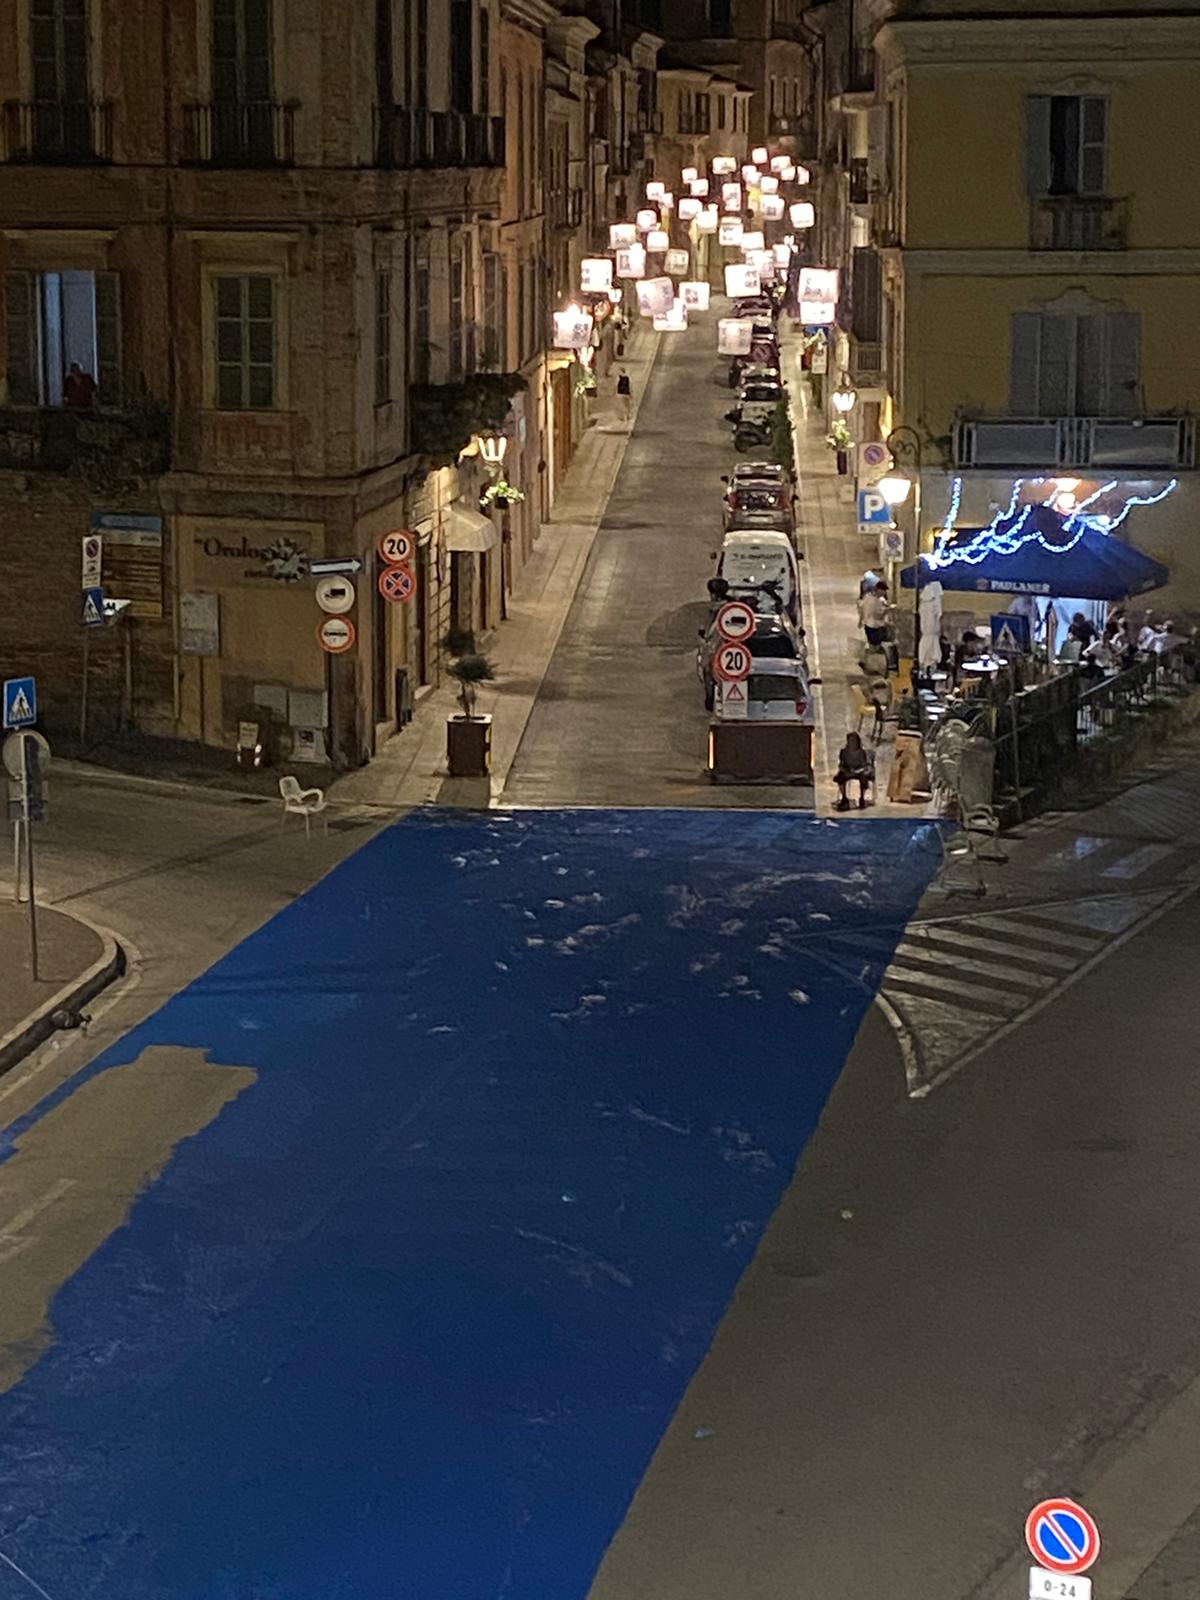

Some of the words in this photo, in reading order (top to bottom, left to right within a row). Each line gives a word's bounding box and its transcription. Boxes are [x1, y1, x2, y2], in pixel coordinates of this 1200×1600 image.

[864, 494, 885, 520] P
[386, 538, 407, 555] 20
[991, 580, 1051, 594] PAULANER
[725, 651, 743, 671] 20
[1044, 1579, 1077, 1598] 0-24
